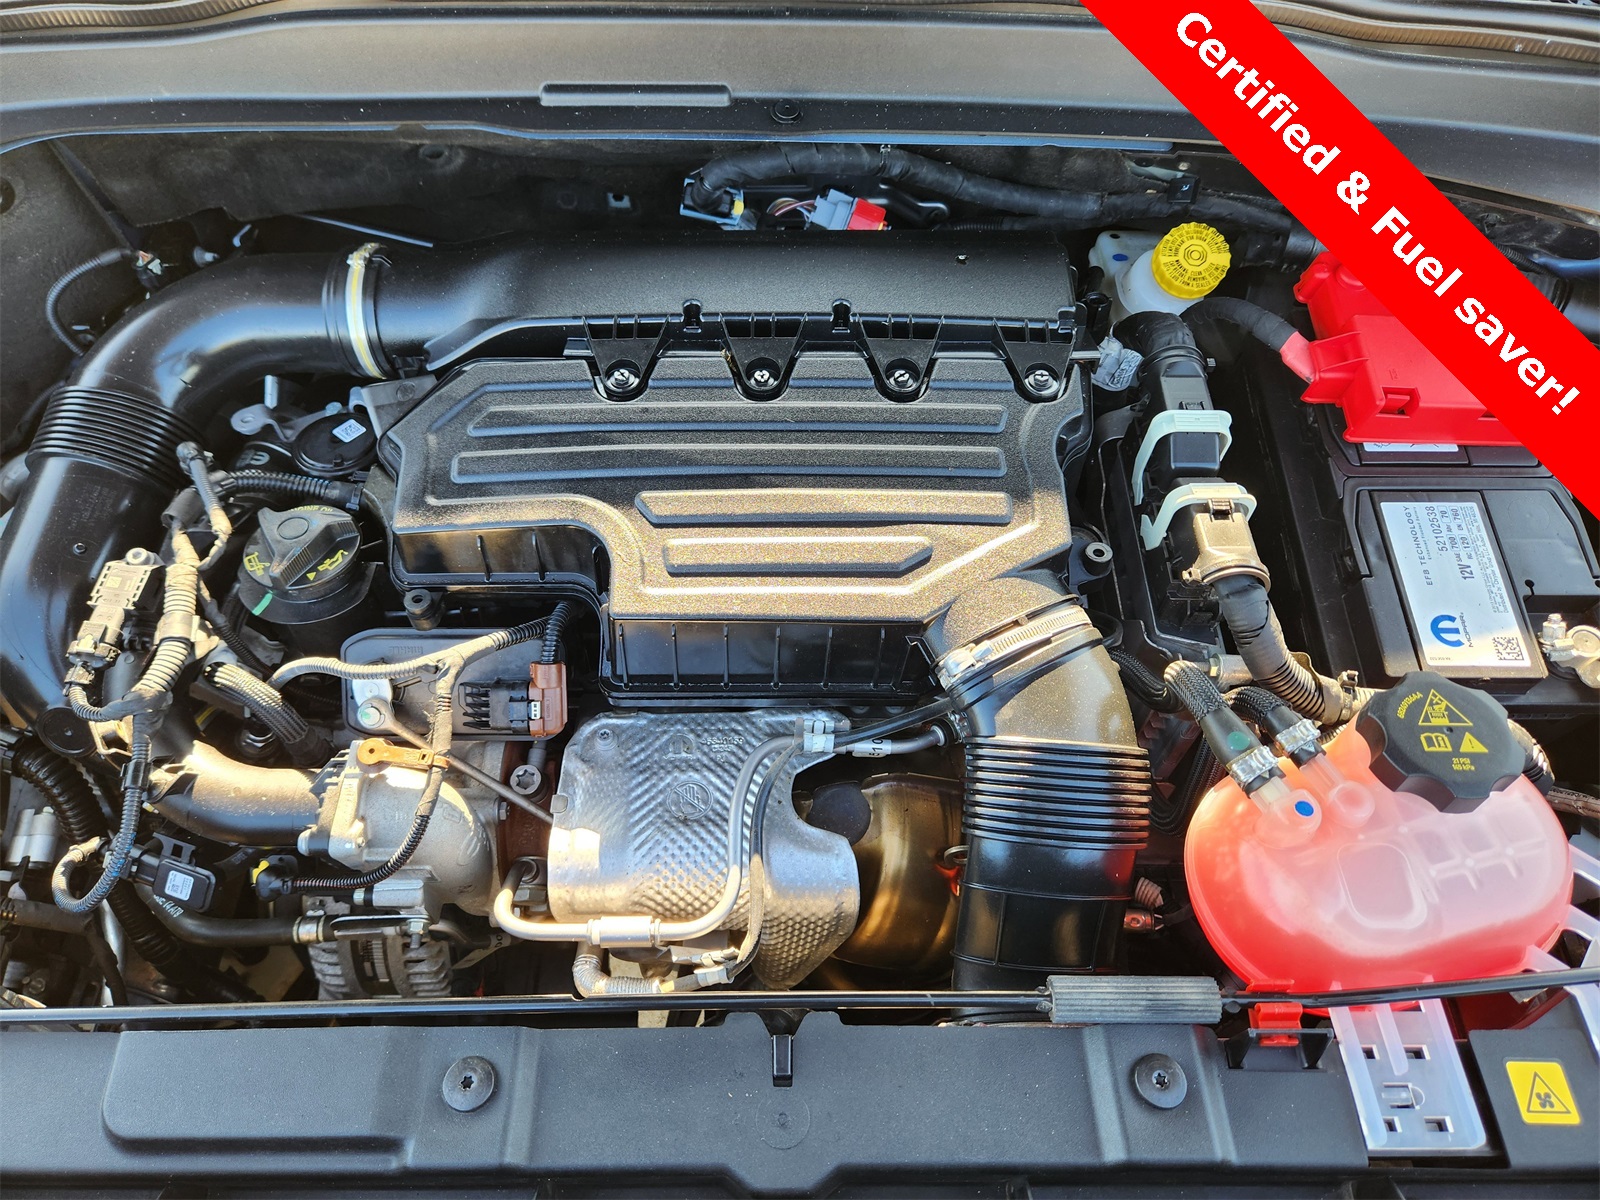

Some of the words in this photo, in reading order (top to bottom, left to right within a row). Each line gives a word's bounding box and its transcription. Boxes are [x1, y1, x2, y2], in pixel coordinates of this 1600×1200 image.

[1440, 510, 1449, 519] 70
[1450, 508, 1461, 521] 760
[1425, 505, 1448, 552] 52102538
[1456, 523, 1464, 531] EN
[1403, 506, 1427, 565] TECHNOLOGY
[1448, 536, 1459, 549] 700
[1460, 536, 1470, 549] 120
[1454, 552, 1463, 562] SAE
[1466, 552, 1474, 560] RC
[1423, 569, 1433, 585] EFB
[1457, 563, 1475, 580] 12V
